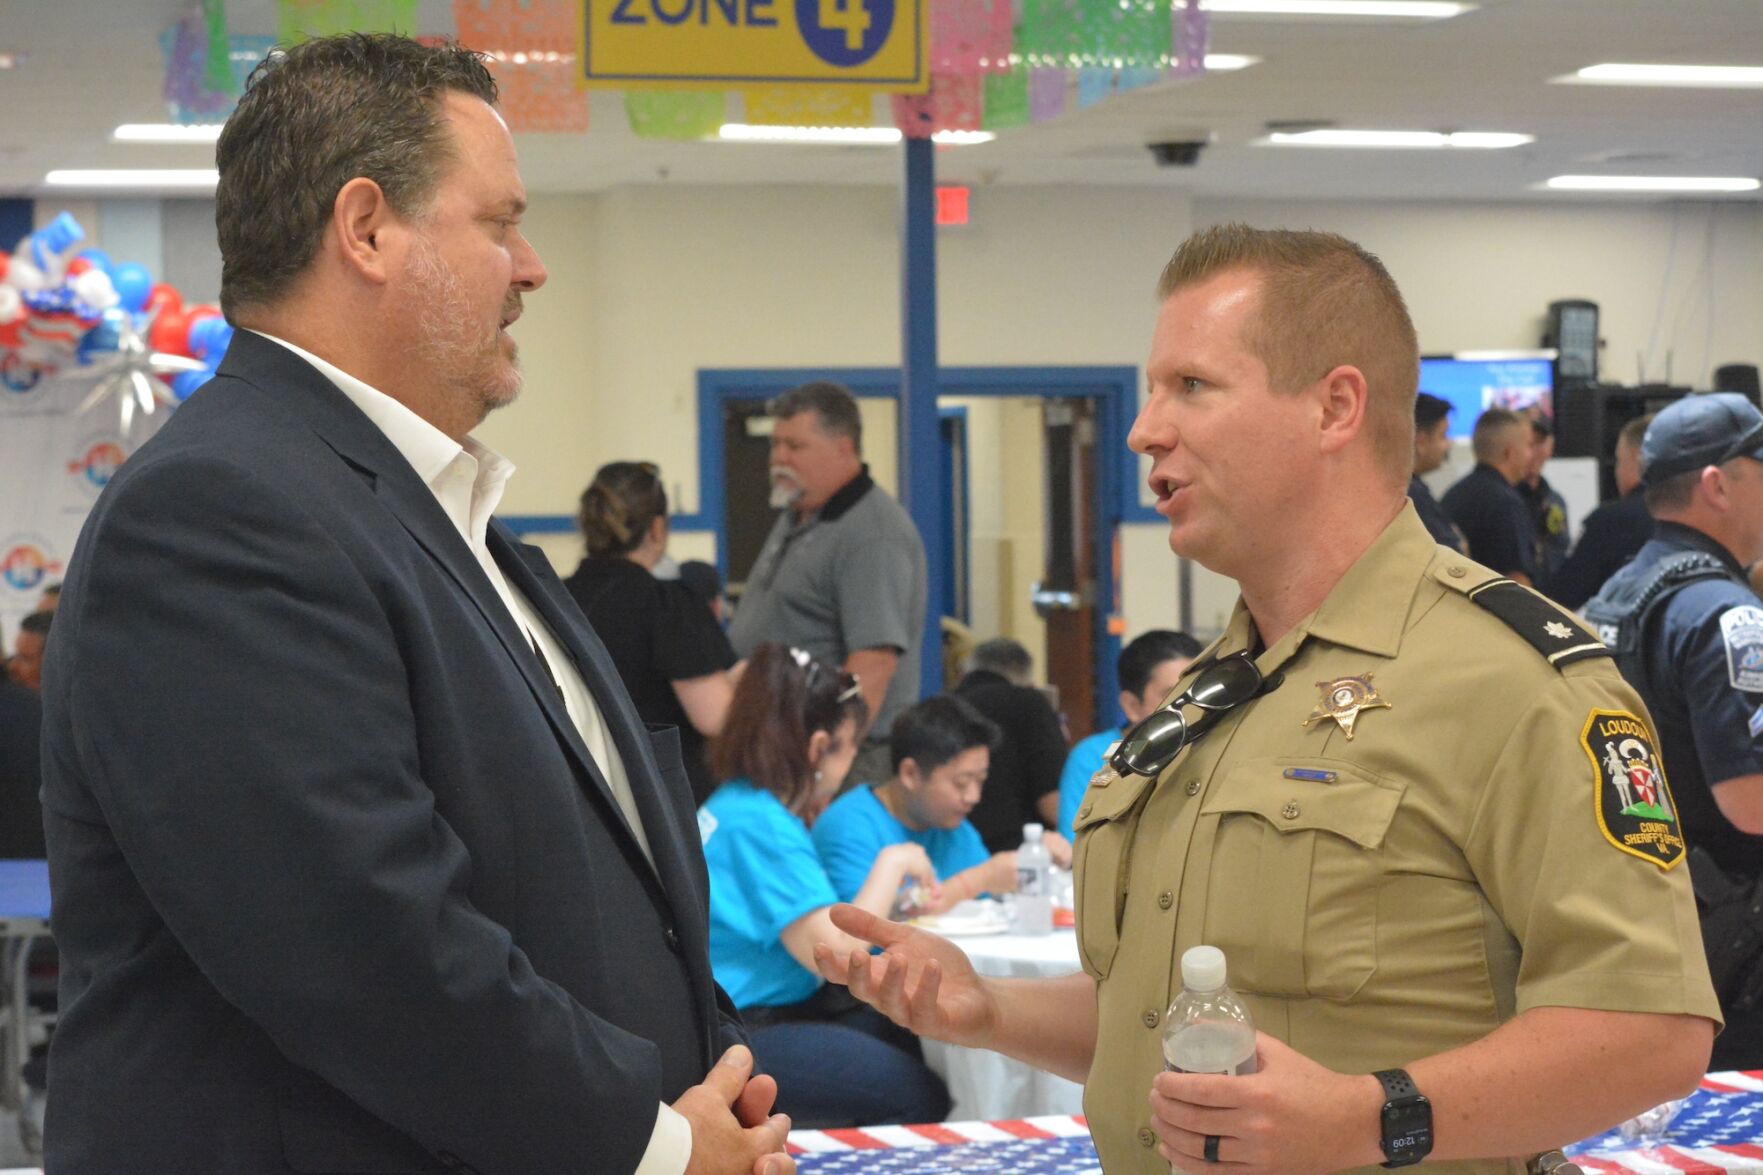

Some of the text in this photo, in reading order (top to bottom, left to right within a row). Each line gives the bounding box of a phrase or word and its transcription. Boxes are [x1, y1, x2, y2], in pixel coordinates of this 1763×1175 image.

[611, 0, 872, 50] ZONE 4
[1393, 1136, 1415, 1148] 12:09
